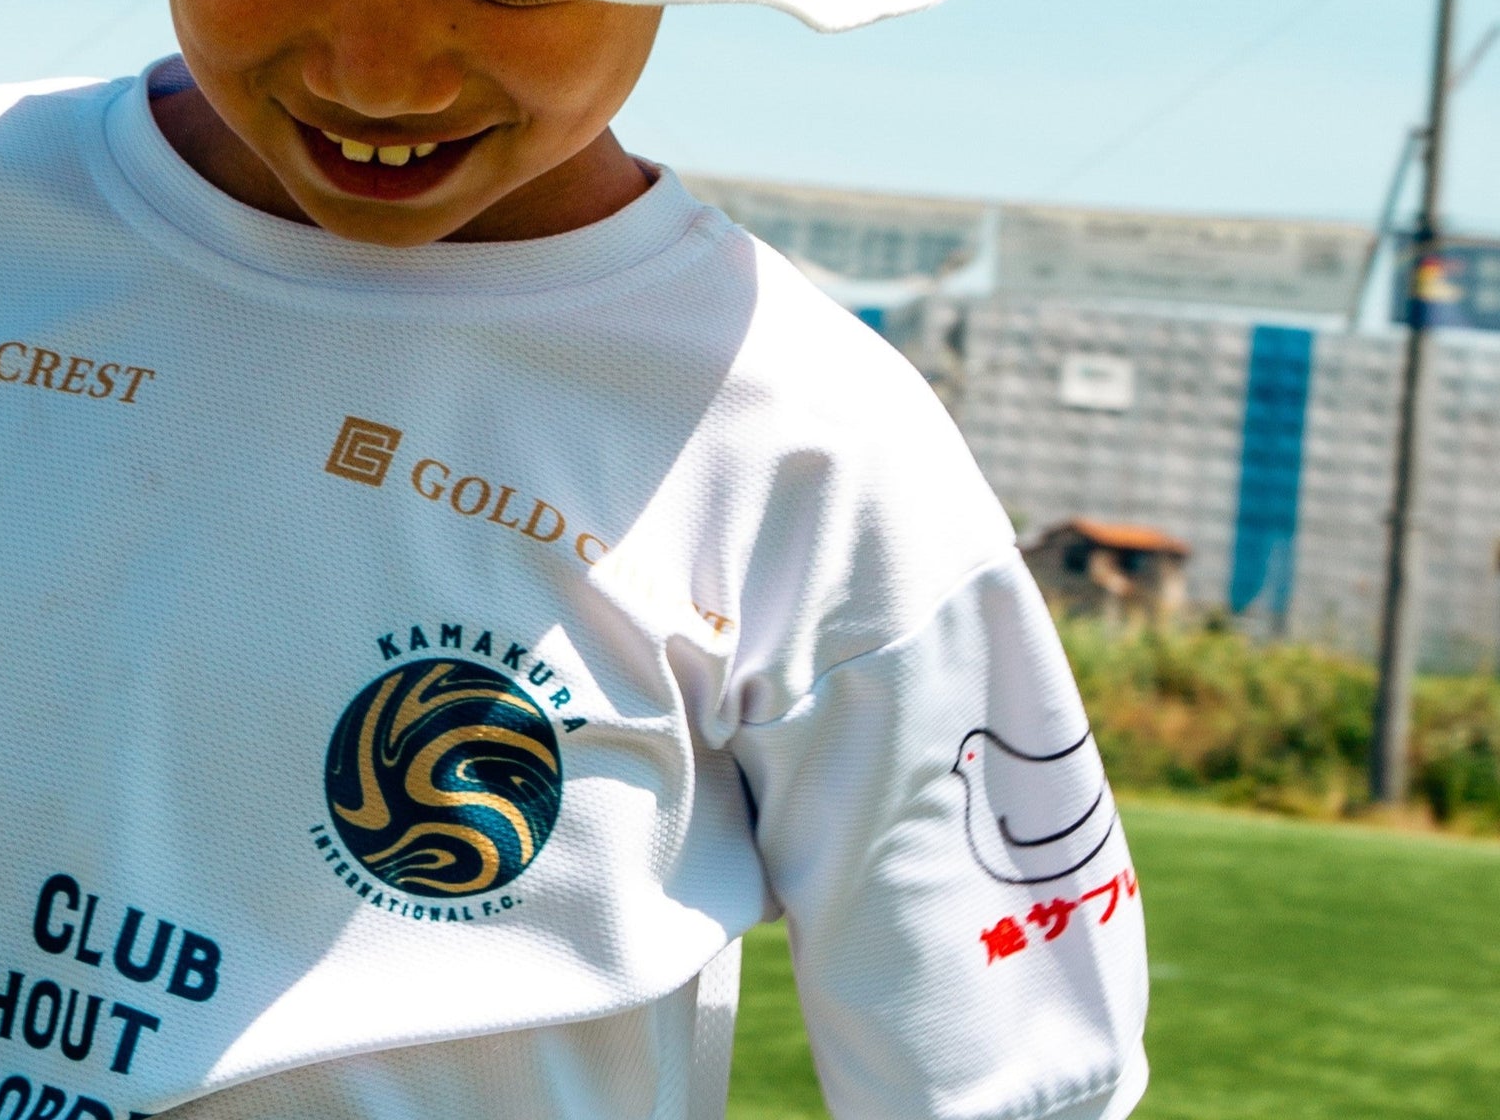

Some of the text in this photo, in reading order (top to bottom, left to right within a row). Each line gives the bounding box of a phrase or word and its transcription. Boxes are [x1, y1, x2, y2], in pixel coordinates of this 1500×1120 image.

[410, 458, 567, 544] GOLD
[376, 623, 588, 734] KAMAKURA
[309, 824, 475, 923] INTERNATIONAL
[33, 873, 222, 1003] CLUB
